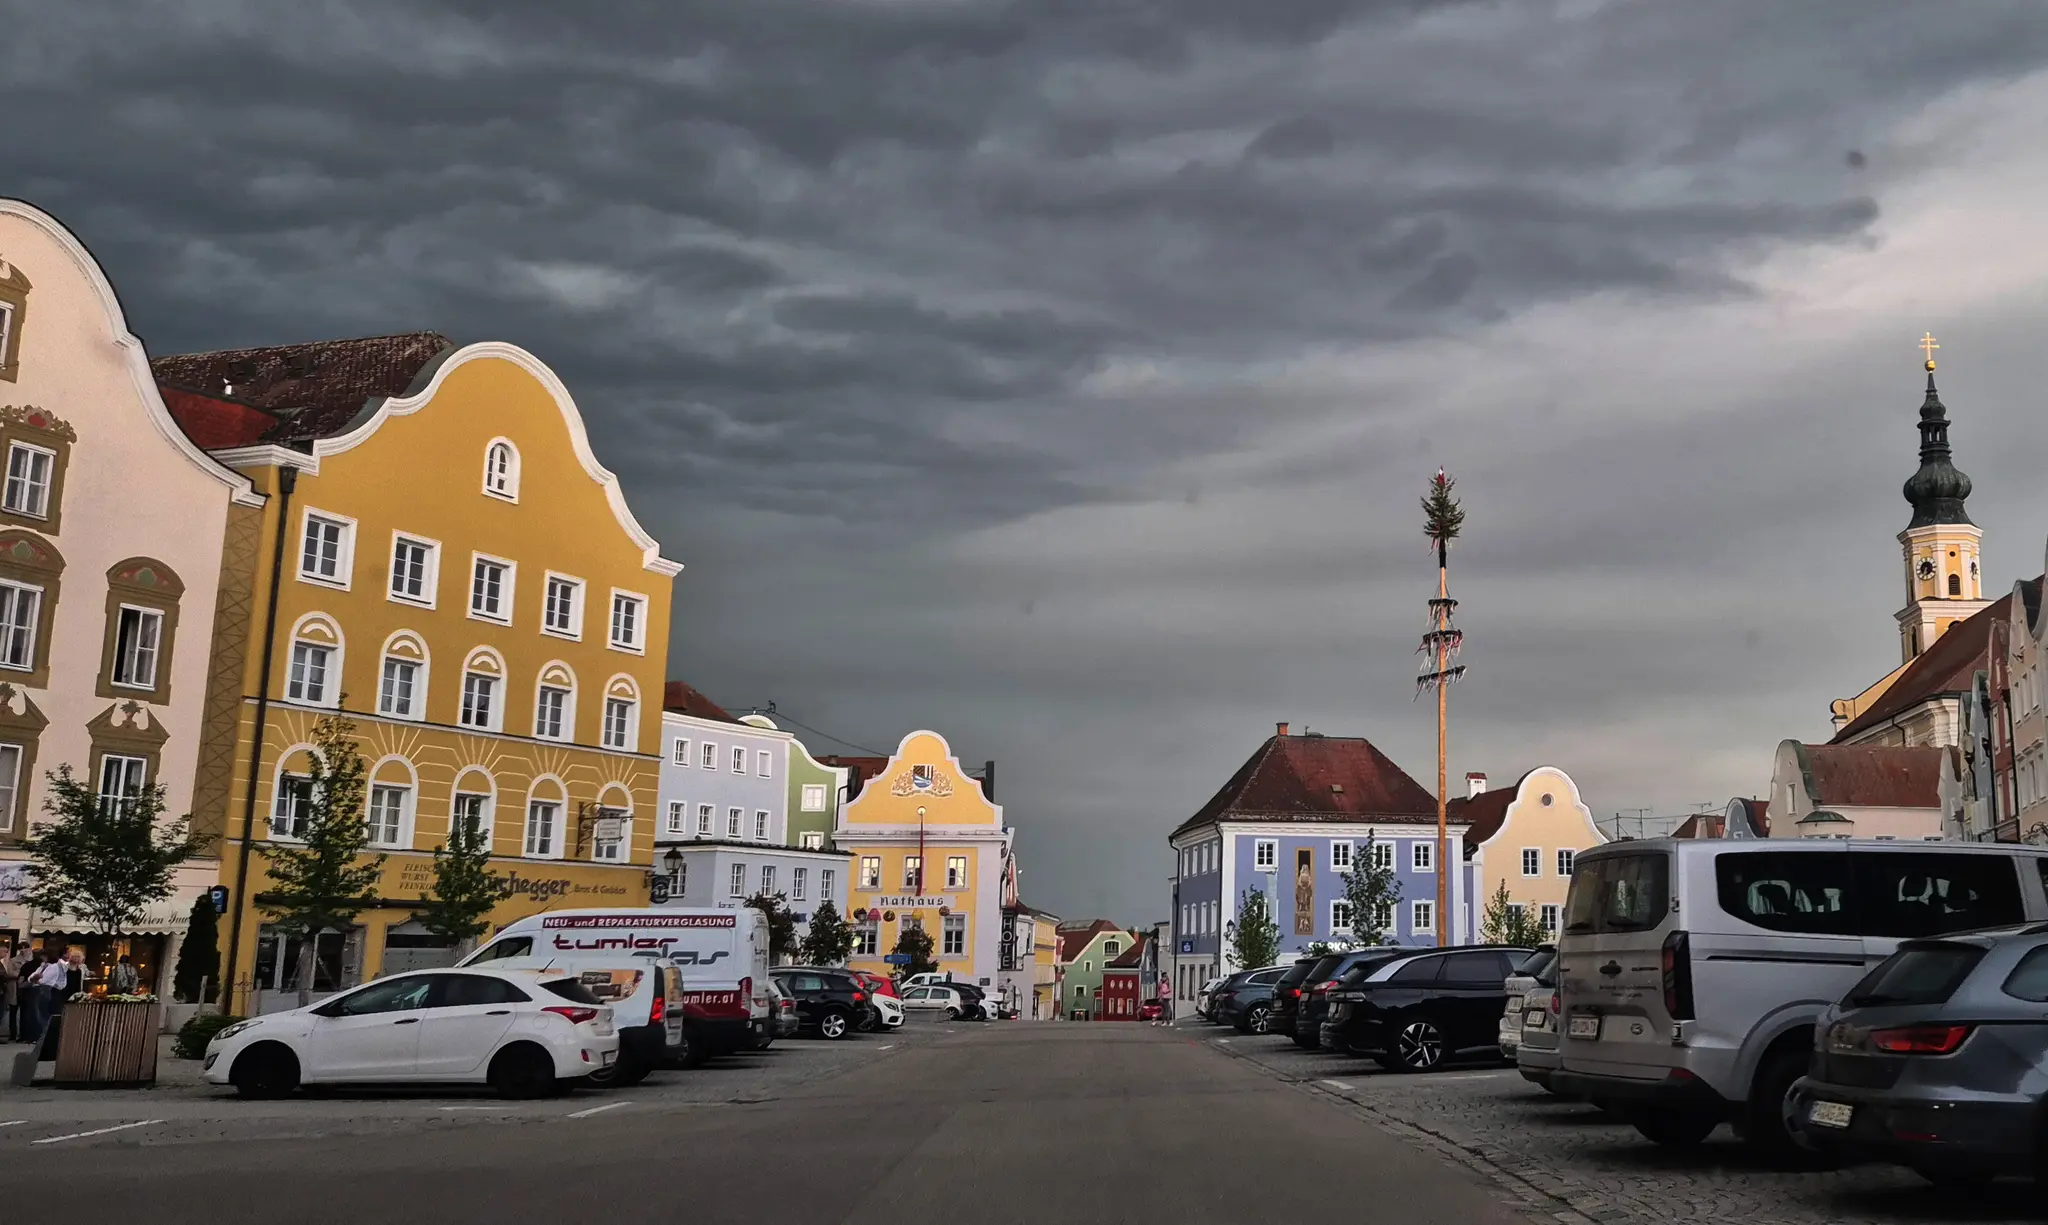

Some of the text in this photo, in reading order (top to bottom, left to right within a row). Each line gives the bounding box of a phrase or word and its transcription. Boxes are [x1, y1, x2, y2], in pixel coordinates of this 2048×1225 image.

[404, 863, 434, 873] FLEISC
[399, 881, 436, 891] FEINKO
[879, 896, 944, 907] Rathaus
[544, 917, 735, 928] NEU- und REPARATURVERGLASUNG
[552, 933, 679, 950] tumler
[1002, 916, 1013, 968] HOTE
[683, 991, 735, 1004] umler.at
